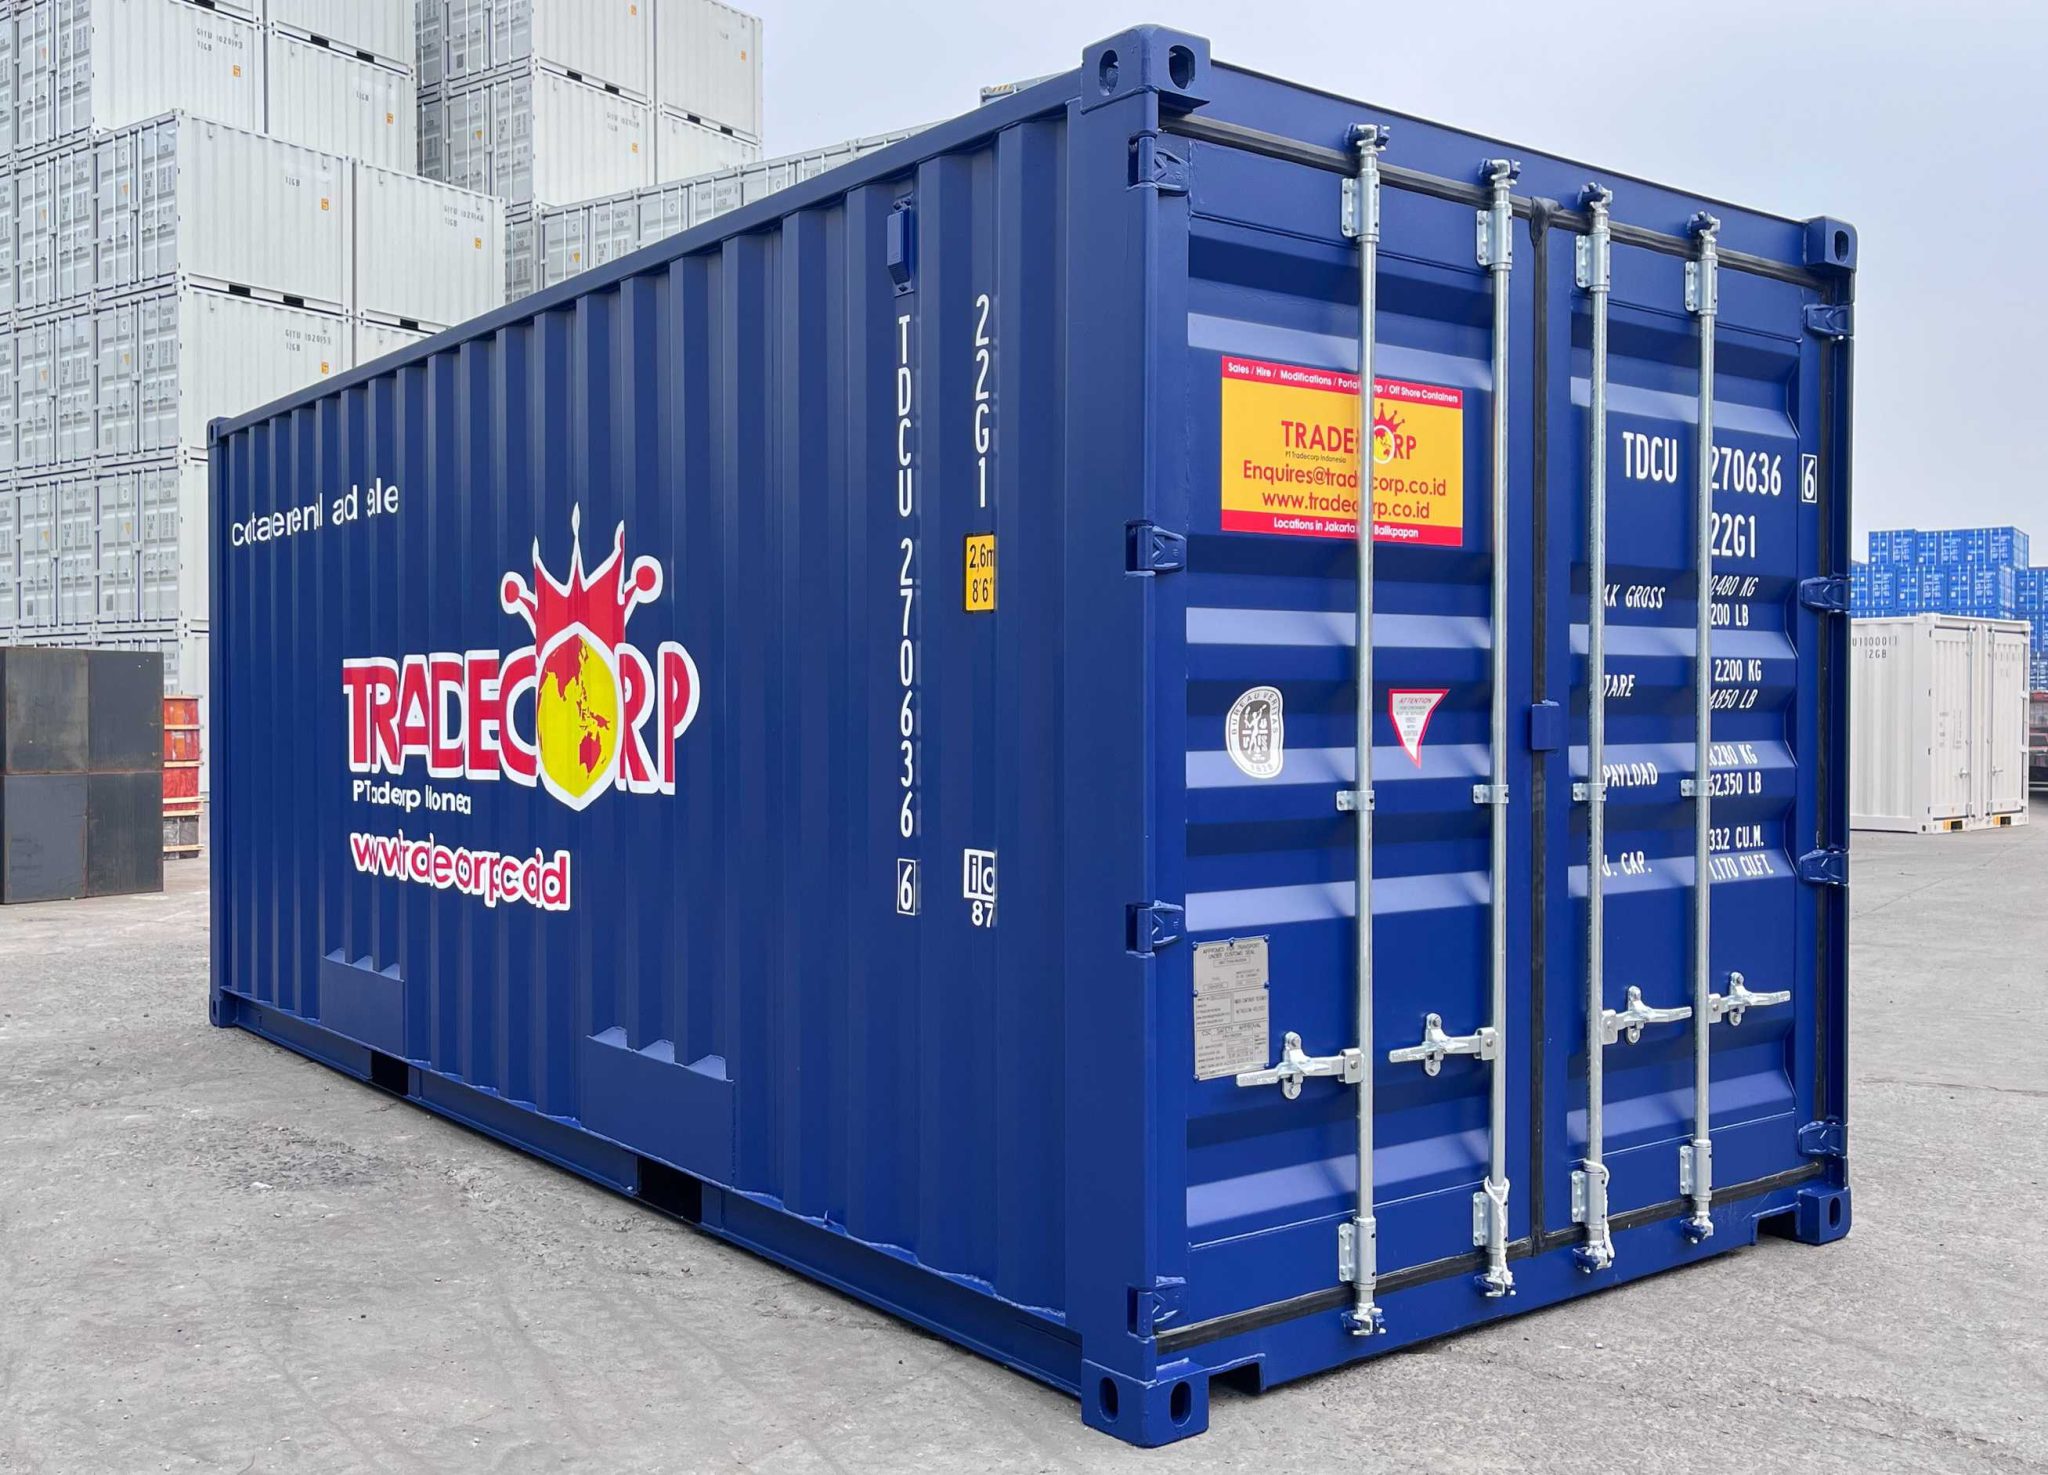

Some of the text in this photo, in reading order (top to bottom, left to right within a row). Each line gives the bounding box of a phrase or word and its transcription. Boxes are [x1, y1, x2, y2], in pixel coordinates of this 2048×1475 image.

[1228, 362, 1250, 375] Sales
[1256, 367, 1271, 377] Hire
[1280, 370, 1332, 386] Modifications
[1389, 385, 1400, 395] Off
[1401, 387, 1421, 398] Shore
[1422, 391, 1458, 403] Containers
[975, 294, 990, 509] 22G1
[1622, 431, 1816, 501] TDCU 270636 6
[1274, 517, 1418, 540] Locations in Jakarta Balikpapan
[1712, 512, 1755, 559] 22G1
[1625, 585, 1666, 609] GROSS
[1739, 576, 1759, 597] KG
[898, 314, 914, 912] TDCU 270636 6
[1735, 604, 1749, 627] LB
[1715, 659, 1762, 682] 2,200 KG
[1604, 674, 1635, 697] TARE
[1739, 689, 1758, 709] LB
[1738, 743, 1758, 765] KG
[1602, 762, 1658, 788] PAYLOAD
[1748, 770, 1762, 795] LB
[1621, 850, 1653, 876] CAP.
[972, 900, 994, 928] 87
